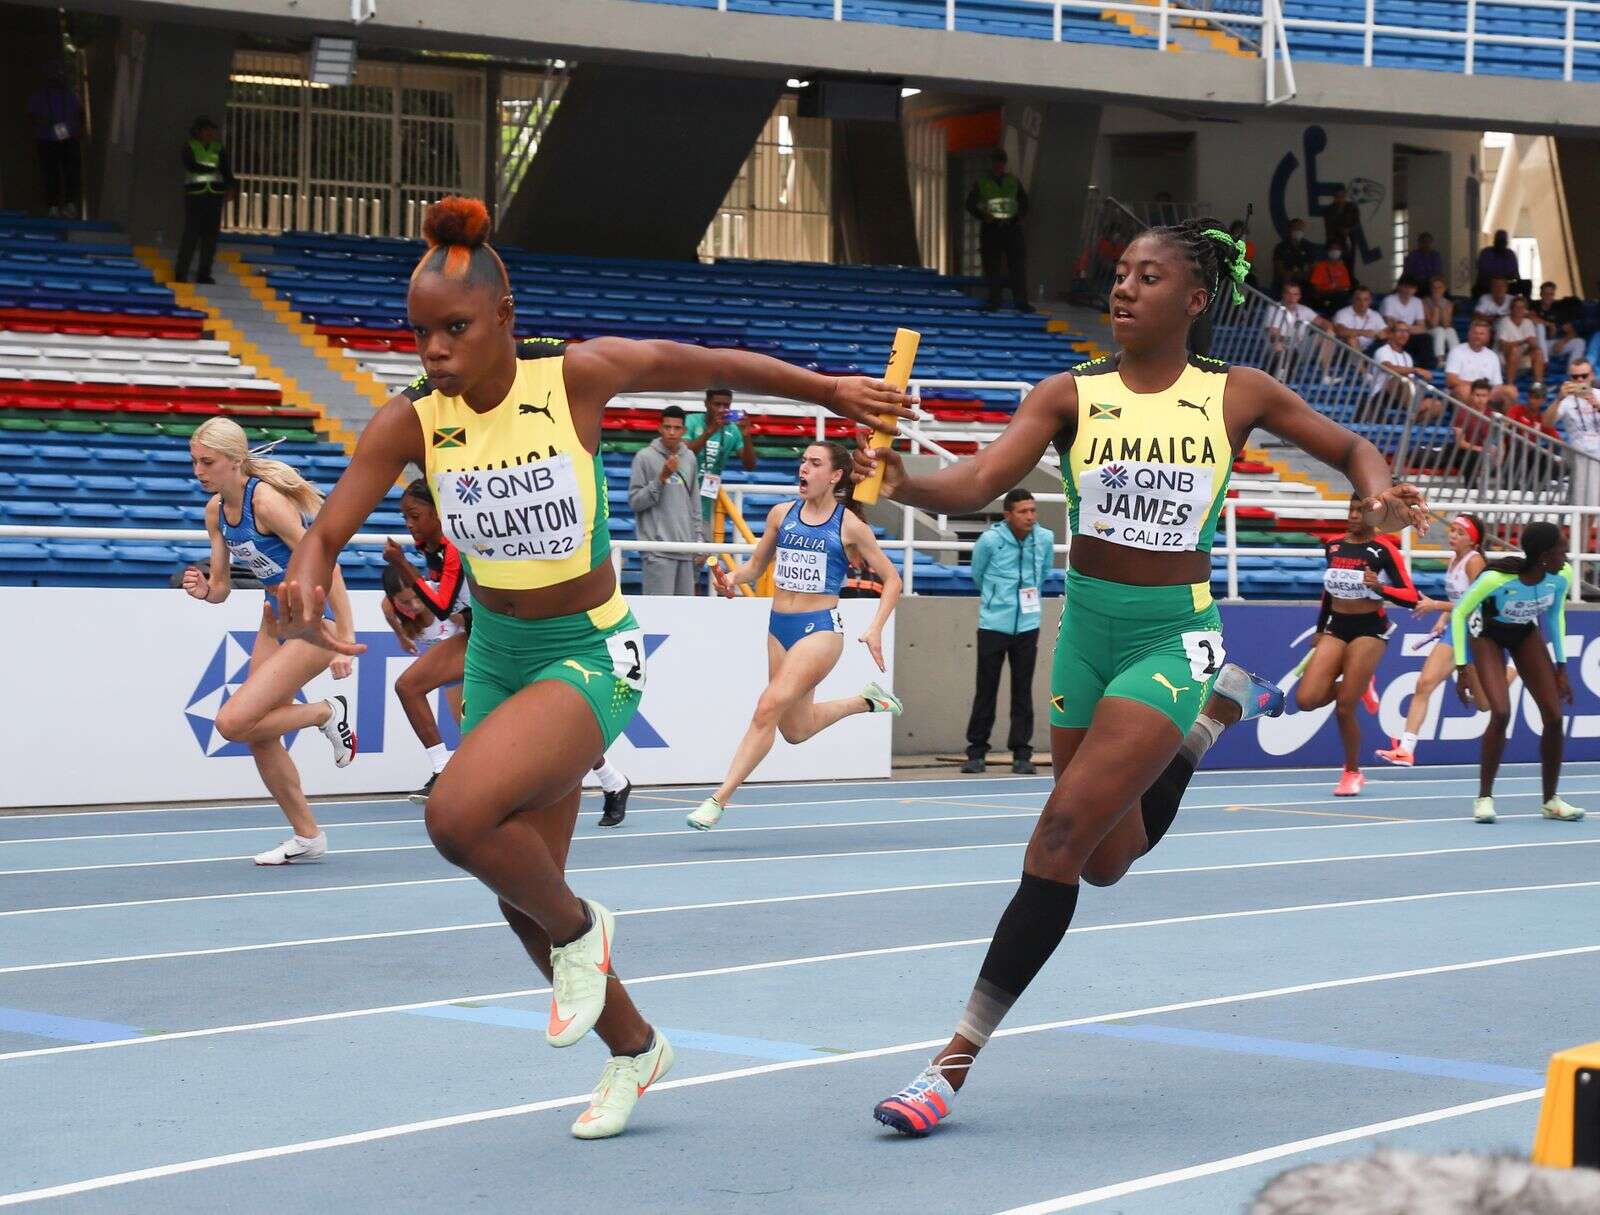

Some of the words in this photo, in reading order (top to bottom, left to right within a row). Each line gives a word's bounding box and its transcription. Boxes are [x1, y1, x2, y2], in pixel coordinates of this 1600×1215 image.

[1083, 436, 1216, 465] JAMAICA
[487, 467, 555, 500] QNB
[1134, 468, 1195, 493] QNB
[447, 513, 475, 540] Ti.
[476, 496, 578, 539] CLAYTON
[1097, 492, 1193, 526] JAMES
[503, 541, 546, 557] CALI
[549, 536, 574, 555] 22
[783, 533, 826, 551] ITALIA
[1123, 527, 1159, 546] CALI
[1162, 532, 1184, 546] 22
[791, 552, 817, 565] QNB
[777, 563, 821, 582] MUSICA
[787, 581, 805, 590] CALI
[806, 583, 817, 591] 22
[624, 640, 642, 681] 2
[1198, 639, 1218, 675] 2
